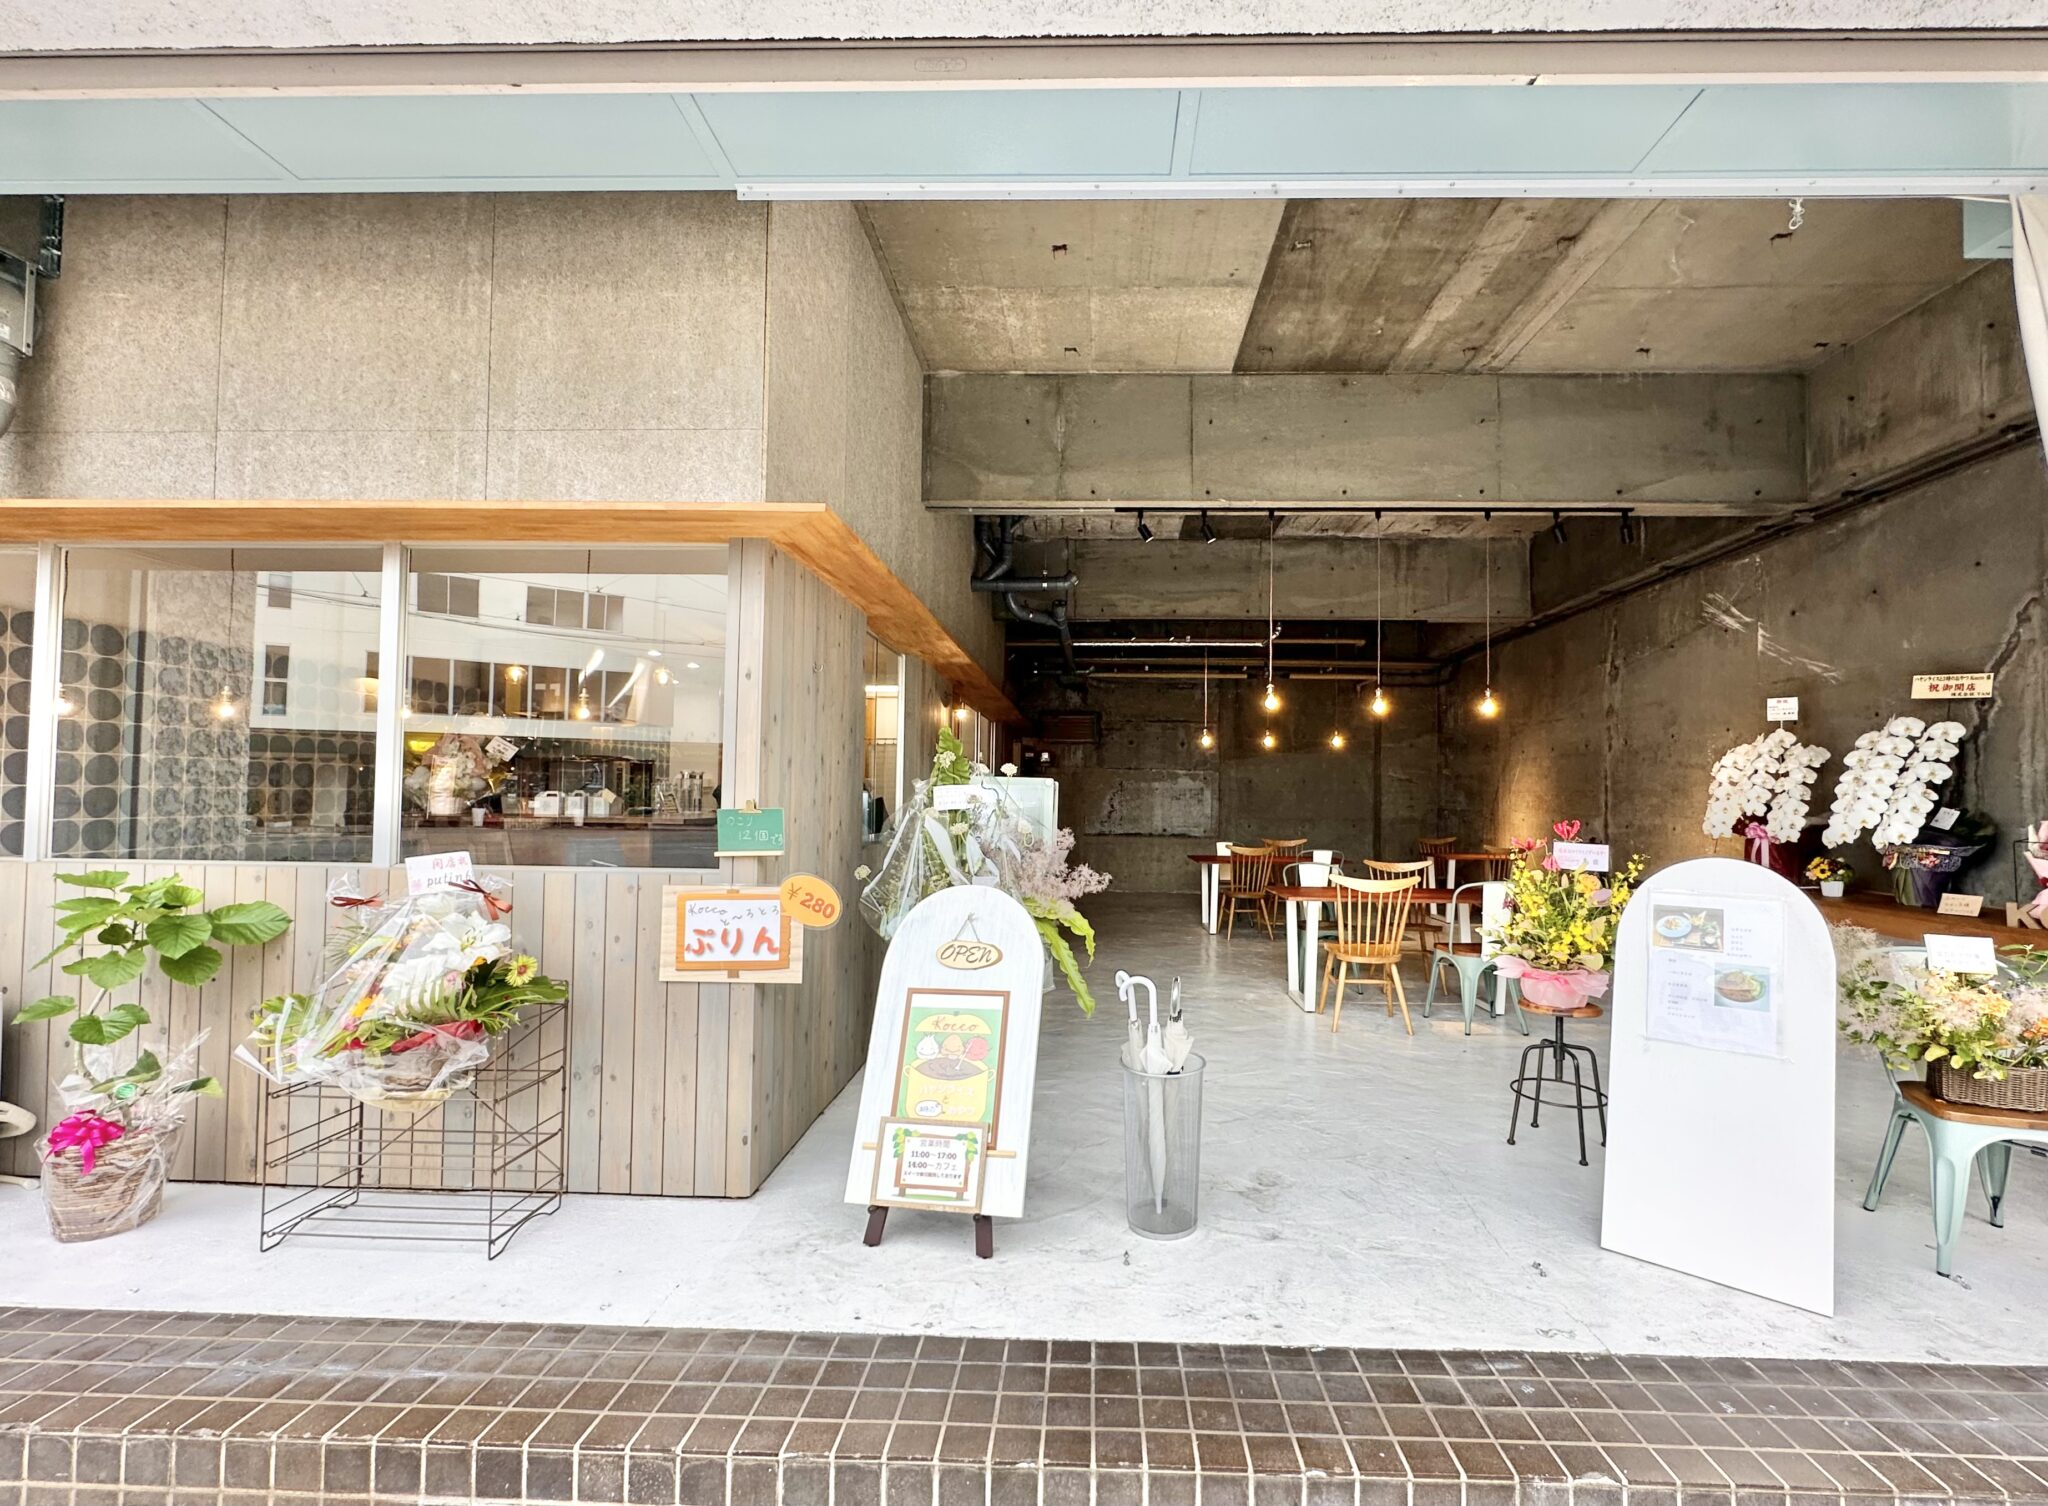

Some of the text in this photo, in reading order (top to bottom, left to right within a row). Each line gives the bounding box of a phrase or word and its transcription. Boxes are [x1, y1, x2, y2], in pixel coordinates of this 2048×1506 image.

[1928, 682, 1976, 692] 祝御開店
[726, 816, 753, 827] のこり
[688, 903, 729, 916] Kocco
[685, 926, 780, 956] ぷりん
[940, 943, 993, 963] OPEN
[932, 1016, 980, 1031] Kocco
[920, 1139, 951, 1149] 営業時間
